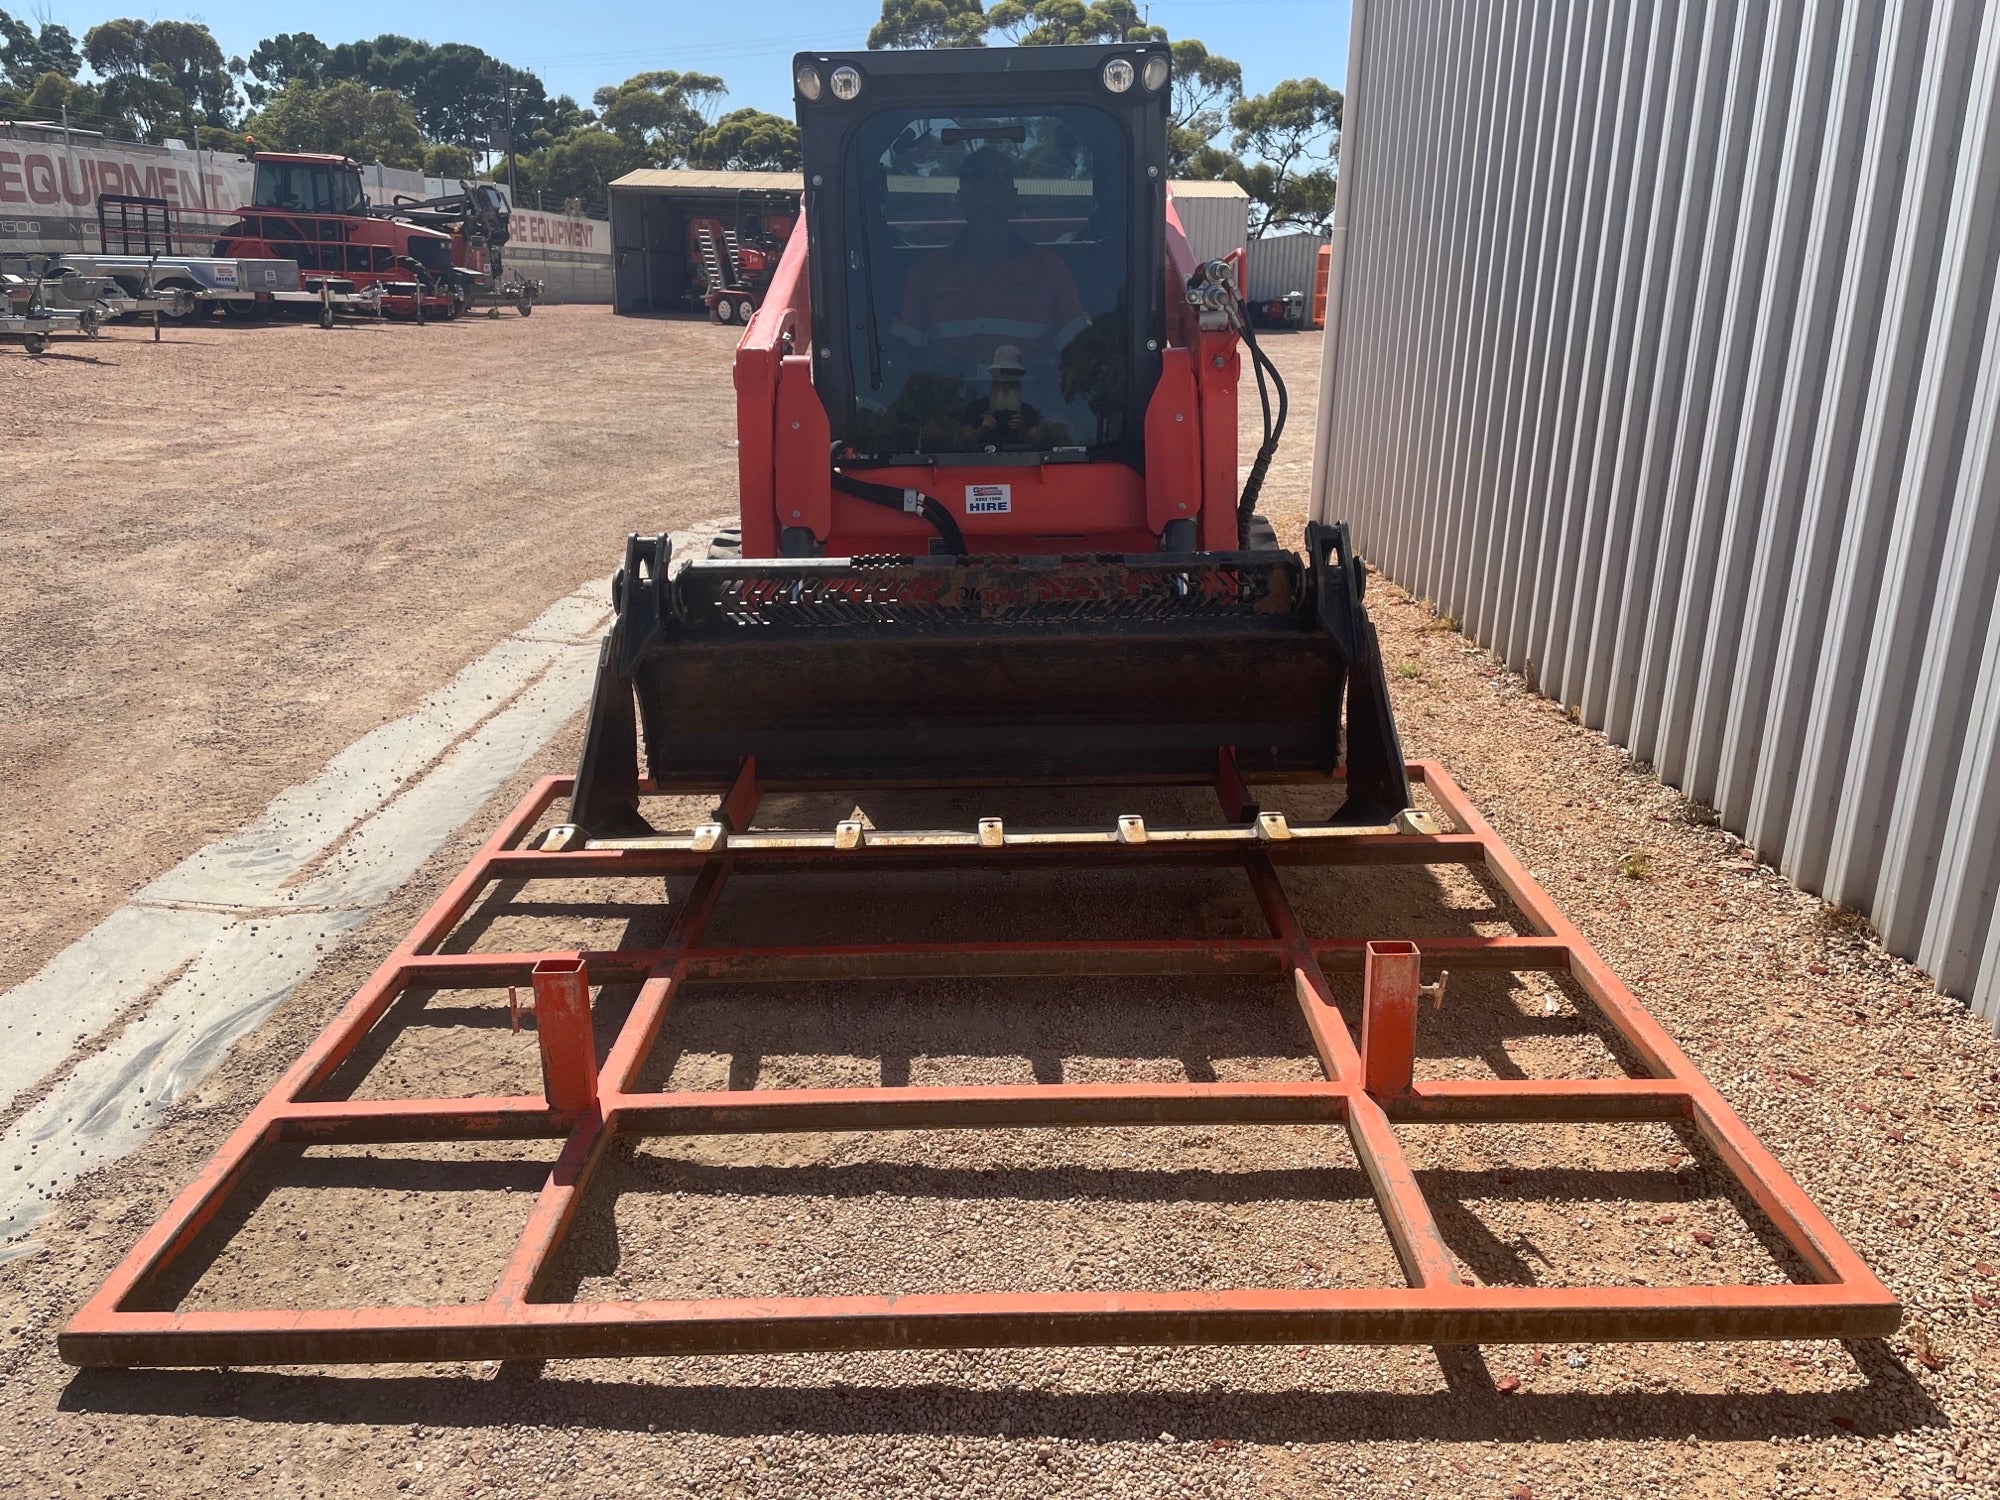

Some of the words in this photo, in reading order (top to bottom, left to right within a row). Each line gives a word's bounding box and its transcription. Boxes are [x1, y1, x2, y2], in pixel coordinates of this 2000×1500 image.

[0, 151, 223, 210] EQUIPMENT
[529, 217, 594, 248] EQUIPMENT
[970, 502, 1008, 511] HIRE
